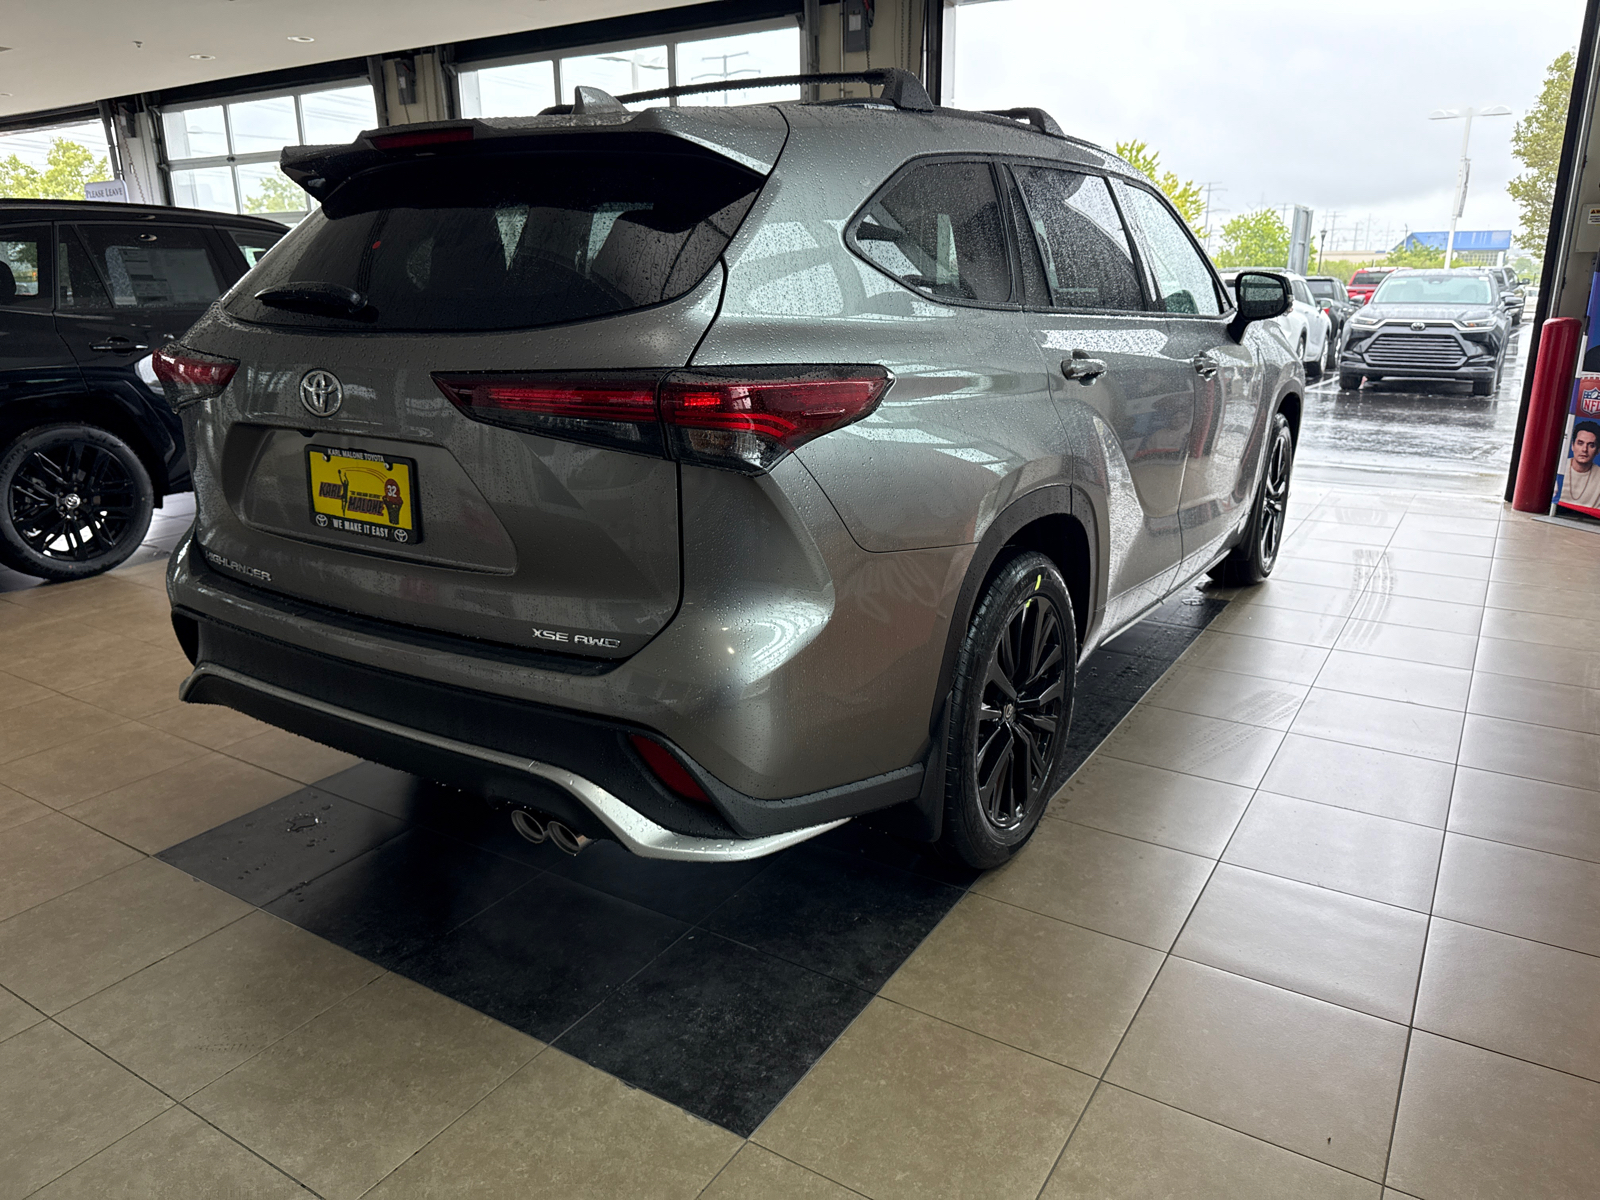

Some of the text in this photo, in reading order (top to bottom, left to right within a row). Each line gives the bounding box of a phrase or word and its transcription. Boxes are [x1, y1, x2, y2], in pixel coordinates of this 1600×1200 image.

[1584, 400, 1600, 411] NFL
[328, 448, 385, 462] KARL MALONE TOYOTA
[319, 482, 343, 499] KARL
[387, 485, 397, 497] 32
[347, 496, 384, 516] MALONE
[333, 518, 388, 538] WE MAKE IT EASY
[205, 550, 271, 581] HIGHLANDER
[532, 628, 621, 649] XSE AWD
